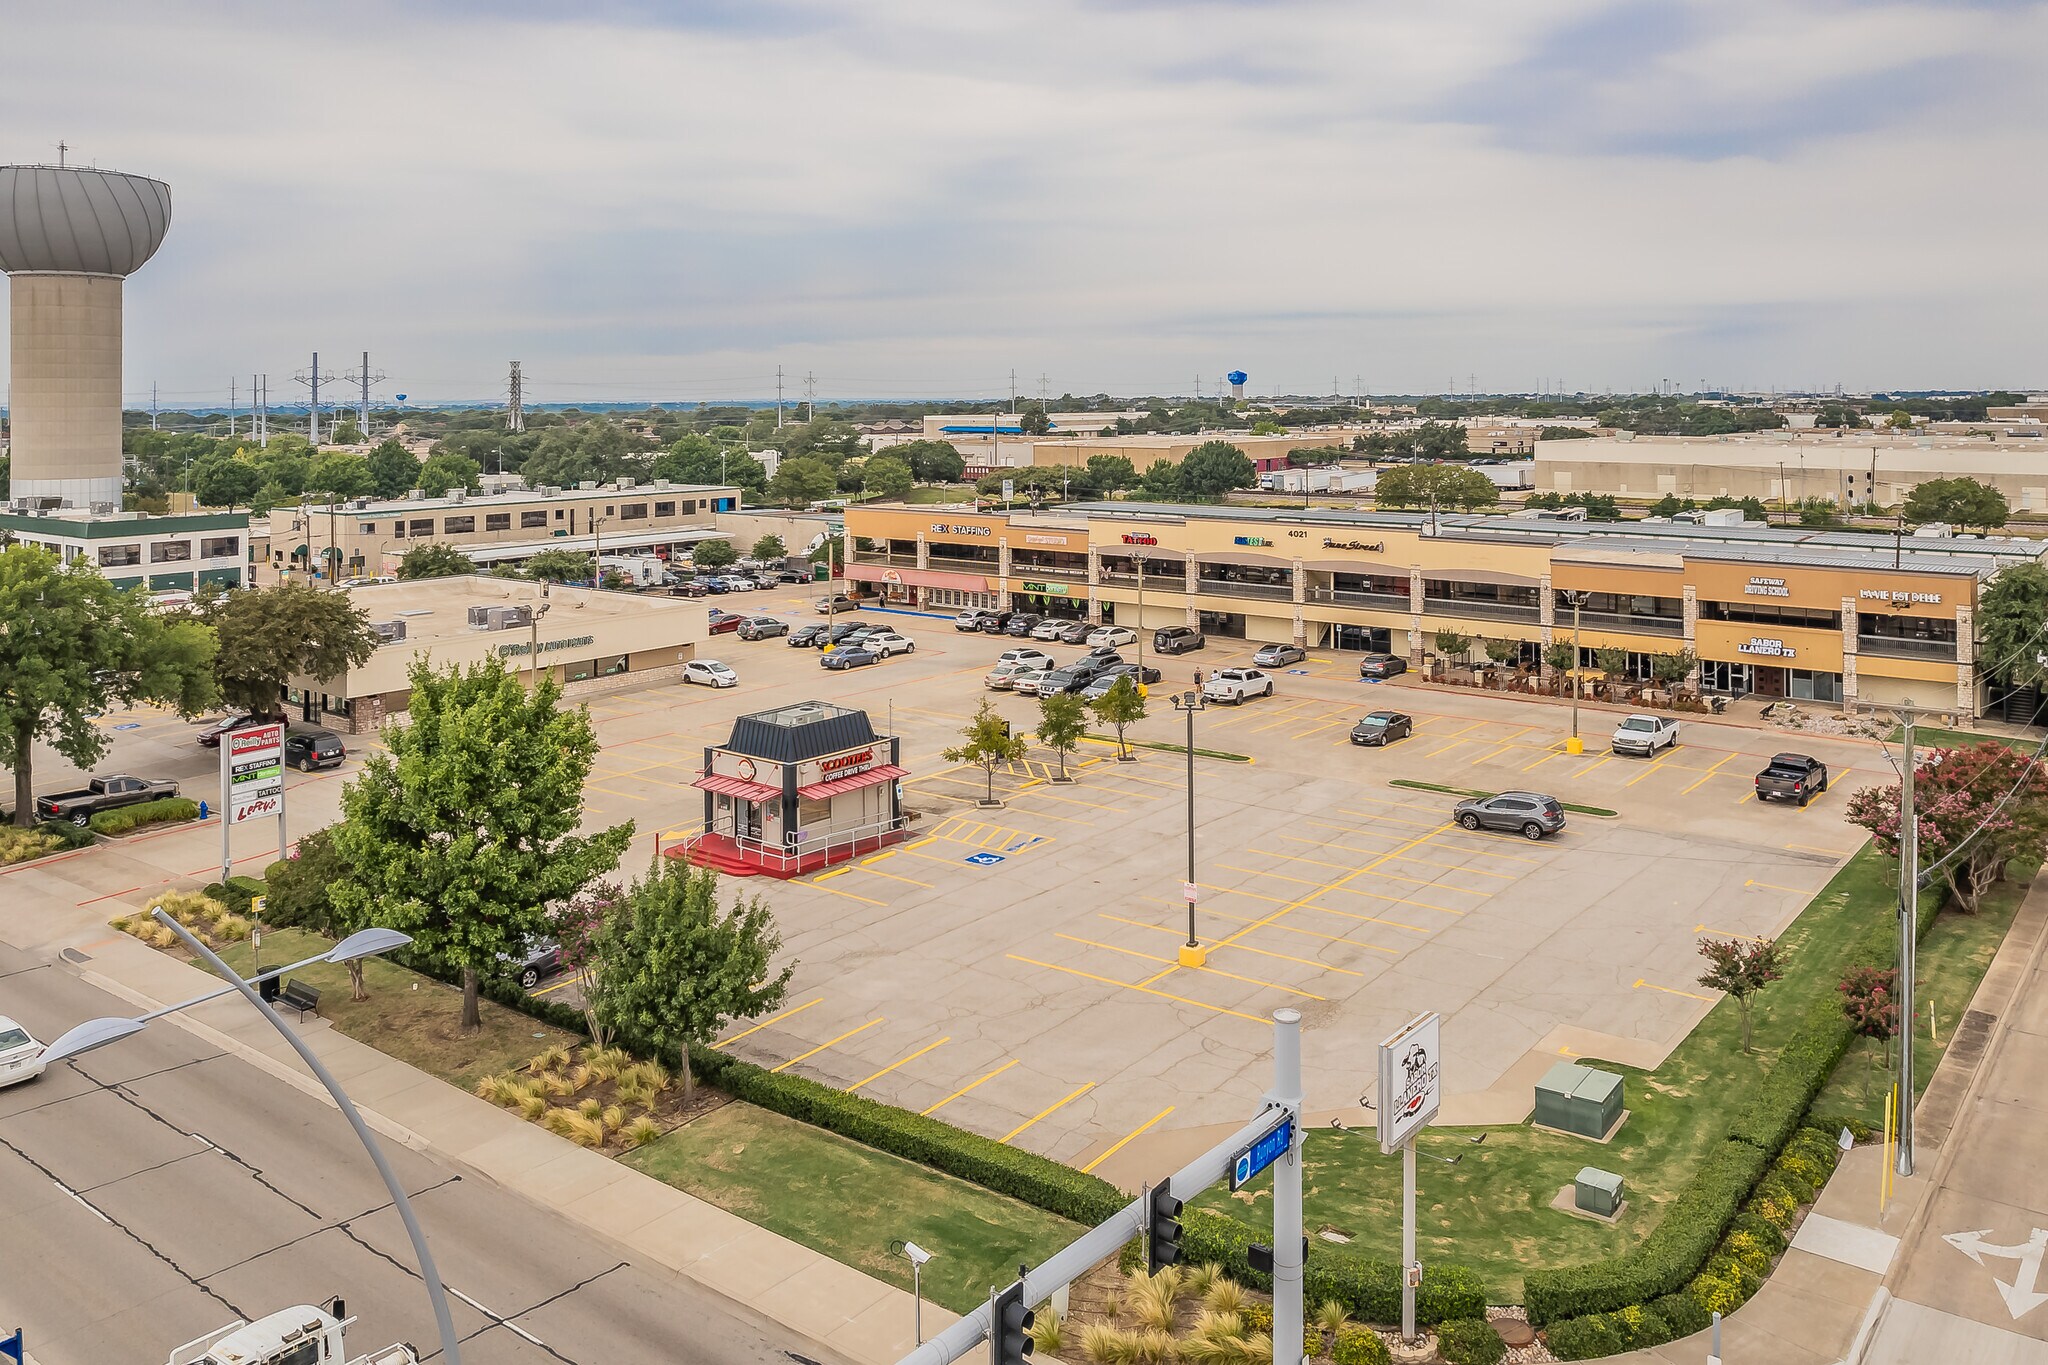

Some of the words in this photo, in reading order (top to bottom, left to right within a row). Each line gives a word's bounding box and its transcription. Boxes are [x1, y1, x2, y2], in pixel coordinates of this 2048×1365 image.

[931, 524, 949, 533] REX
[952, 525, 991, 536] STAFFING
[1288, 530, 1308, 538] 4021
[1749, 577, 1785, 586] SAFEWAY
[1744, 584, 1768, 595] DRIVING
[1767, 587, 1790, 597] SCHOOL
[1892, 591, 1910, 601] EST
[1750, 637, 1783, 648] SABOR
[499, 640, 544, 658] O'Reily
[544, 641, 567, 652] AUTO
[1737, 644, 1781, 656] LLANERO
[1782, 648, 1796, 658] TX
[262, 730, 279, 739] AUTO
[261, 737, 280, 746] PARTS
[235, 764, 249, 773] REX
[248, 758, 277, 770] STAFFING
[824, 770, 844, 782] COFFEE
[844, 766, 858, 777] DRIVE
[1394, 1073, 1428, 1116] LLANERO
